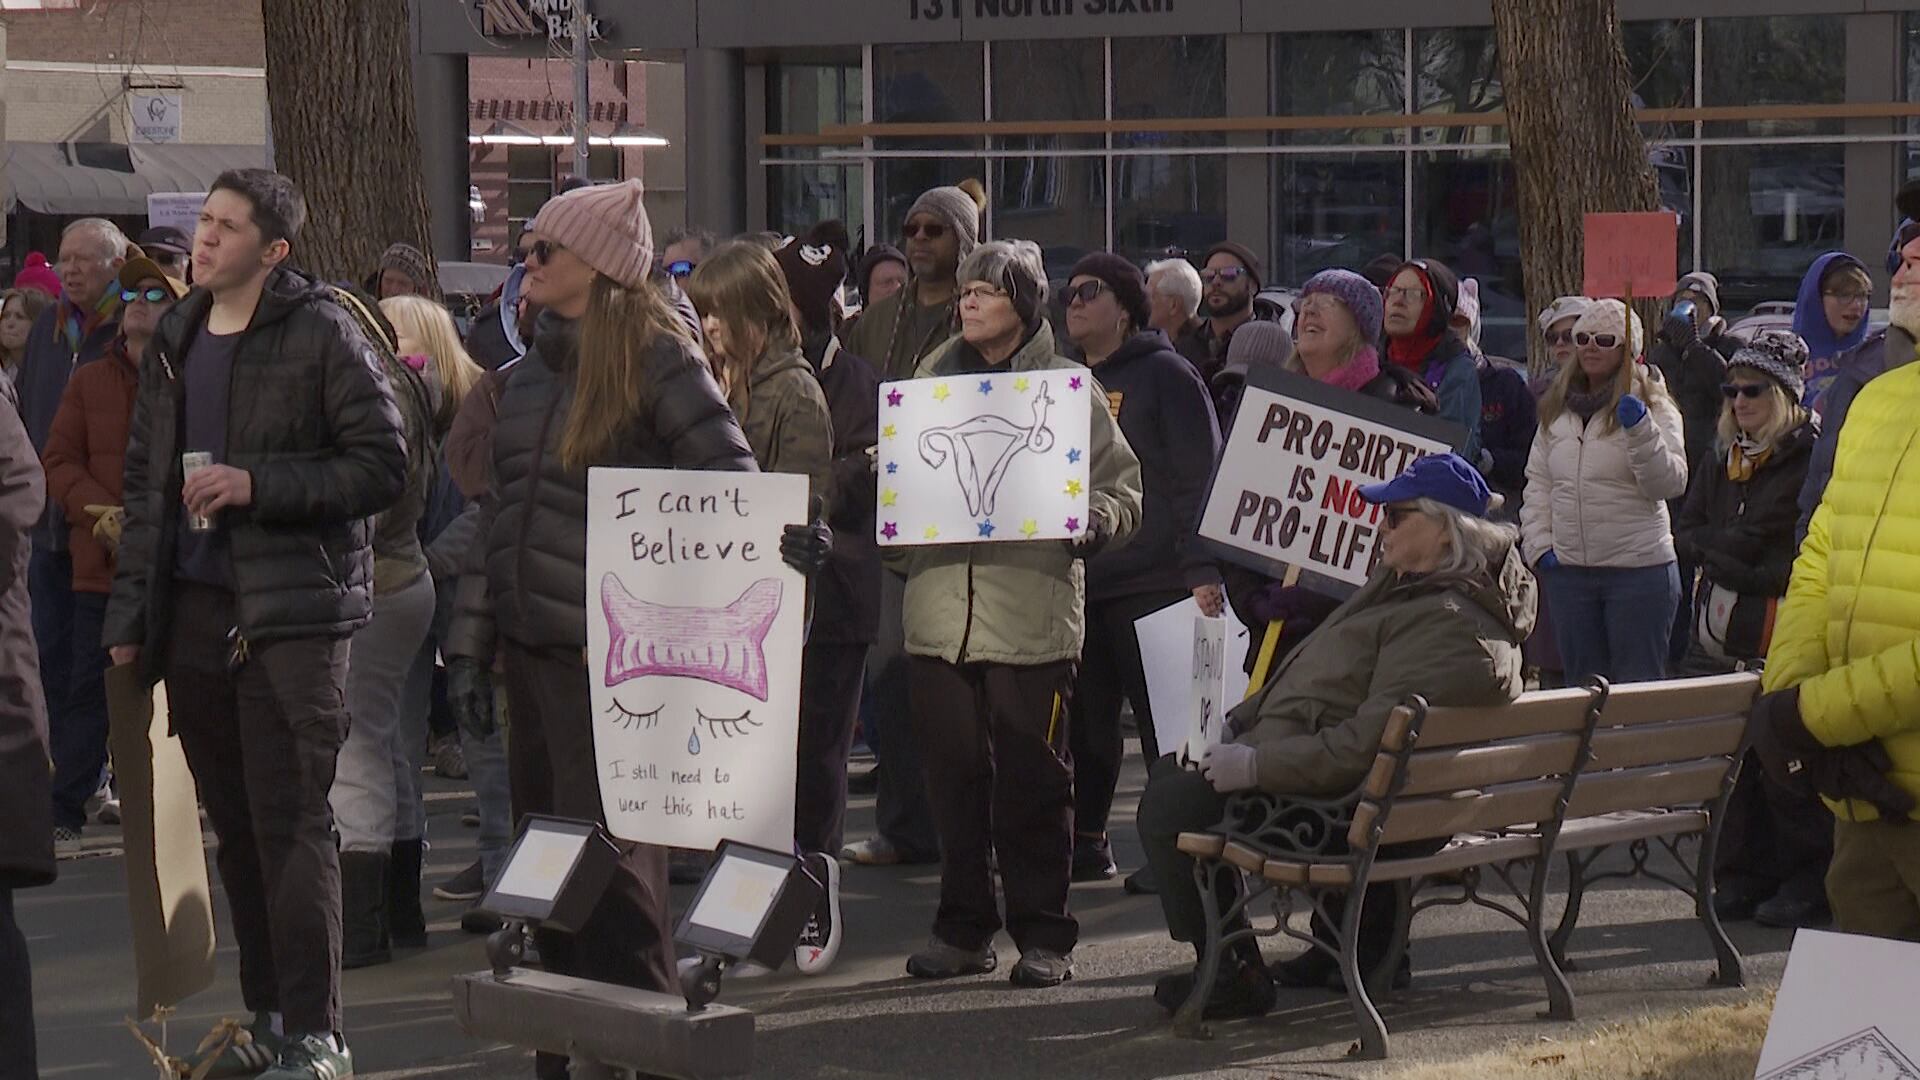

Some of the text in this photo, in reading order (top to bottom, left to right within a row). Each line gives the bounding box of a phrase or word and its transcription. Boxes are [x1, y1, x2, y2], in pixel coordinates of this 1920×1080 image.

[975, 0, 1073, 18] North
[549, 14, 600, 38] Bak
[1256, 402, 1433, 481] PRO-BIRT
[1287, 464, 1316, 503] IS
[615, 487, 751, 520] I can't
[630, 526, 761, 565] Believe
[608, 758, 731, 785] I still need to
[618, 794, 746, 821] wear this hat
